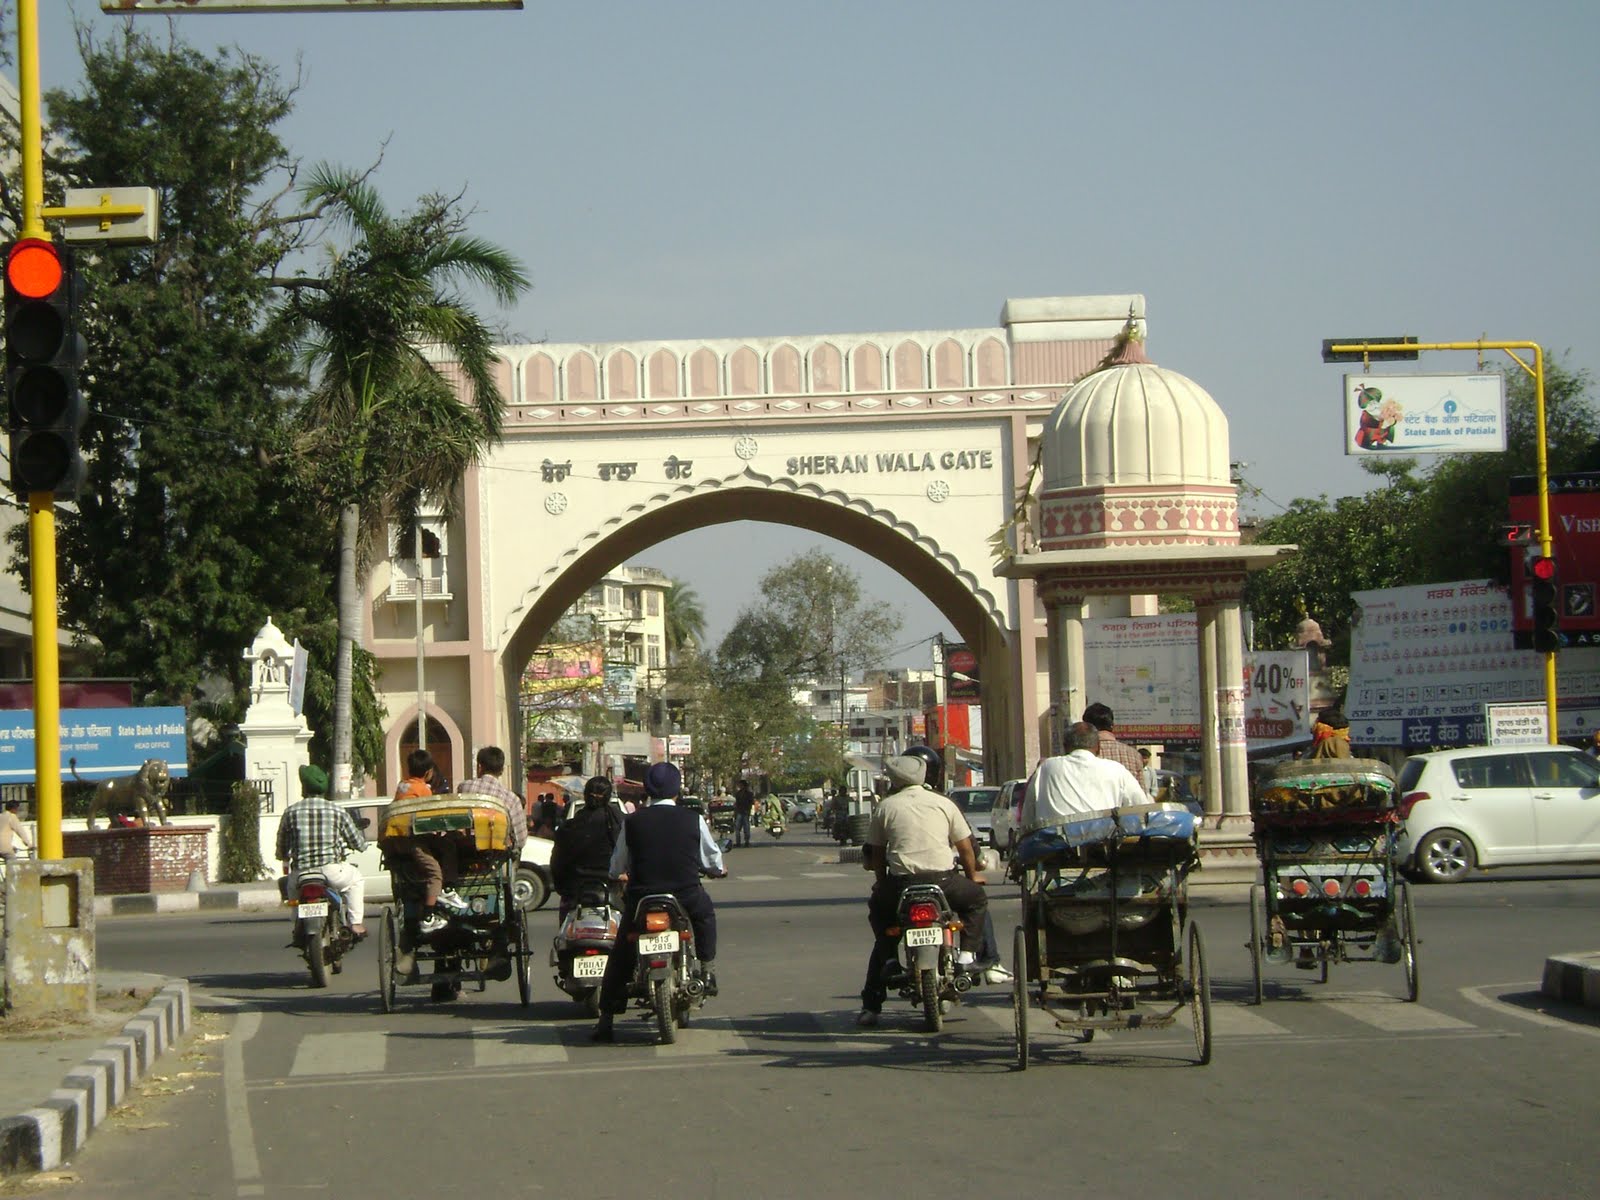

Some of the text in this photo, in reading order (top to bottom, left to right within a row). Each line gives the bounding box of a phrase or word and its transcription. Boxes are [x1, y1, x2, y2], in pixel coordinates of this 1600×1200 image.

[1405, 426, 1496, 436] State Bank of Patiala
[786, 450, 993, 476] SHERAN WALA GATE
[118, 723, 184, 736] State Bank of Patiala
[151, 741, 170, 749] OFFICE
[649, 935, 669, 943] PB13
[652, 943, 672, 951] 2819
